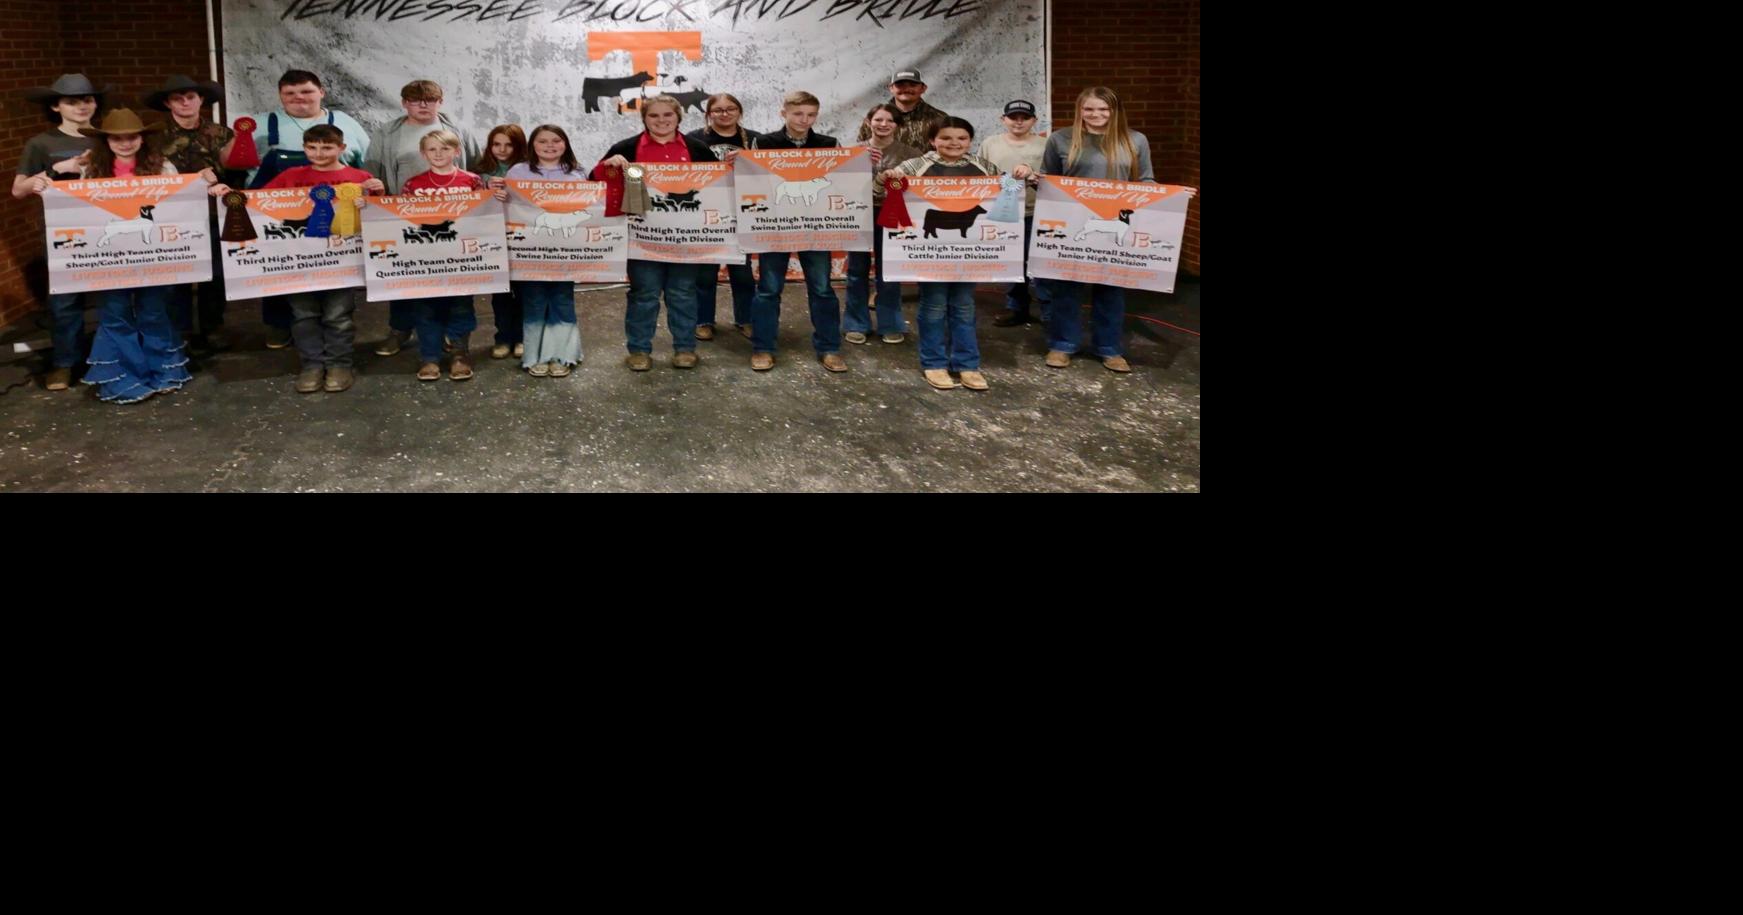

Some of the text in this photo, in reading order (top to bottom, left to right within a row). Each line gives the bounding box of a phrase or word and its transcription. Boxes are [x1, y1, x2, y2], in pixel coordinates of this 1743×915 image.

[769, 150, 803, 158] BLOCK
[769, 159, 811, 170] Round
[647, 171, 687, 182] Round
[69, 177, 183, 190] UT BLOCK & BRIDLE
[1060, 178, 1074, 186] UT
[1076, 180, 1114, 189] BLOCK
[1126, 184, 1167, 193] BRIDLE
[256, 190, 294, 199] BLOCK
[922, 185, 965, 198] Round
[397, 196, 432, 204] BLOCK
[445, 193, 481, 201] BRIDLE
[636, 233, 663, 241] Junior
[101, 250, 125, 259] High
[236, 247, 362, 265] Third High Team Overall
[1036, 242, 1058, 251] High
[1085, 247, 1117, 256] Overall
[1120, 251, 1172, 262] Sheep/Goat
[66, 254, 197, 269] Sheep/Goat Junior Division
[263, 259, 340, 273] Junior Division
[392, 255, 482, 269] High Team Overall
[1087, 255, 1108, 264] High
[1110, 258, 1147, 267] Division
[376, 264, 500, 278] Questions Junior Division
